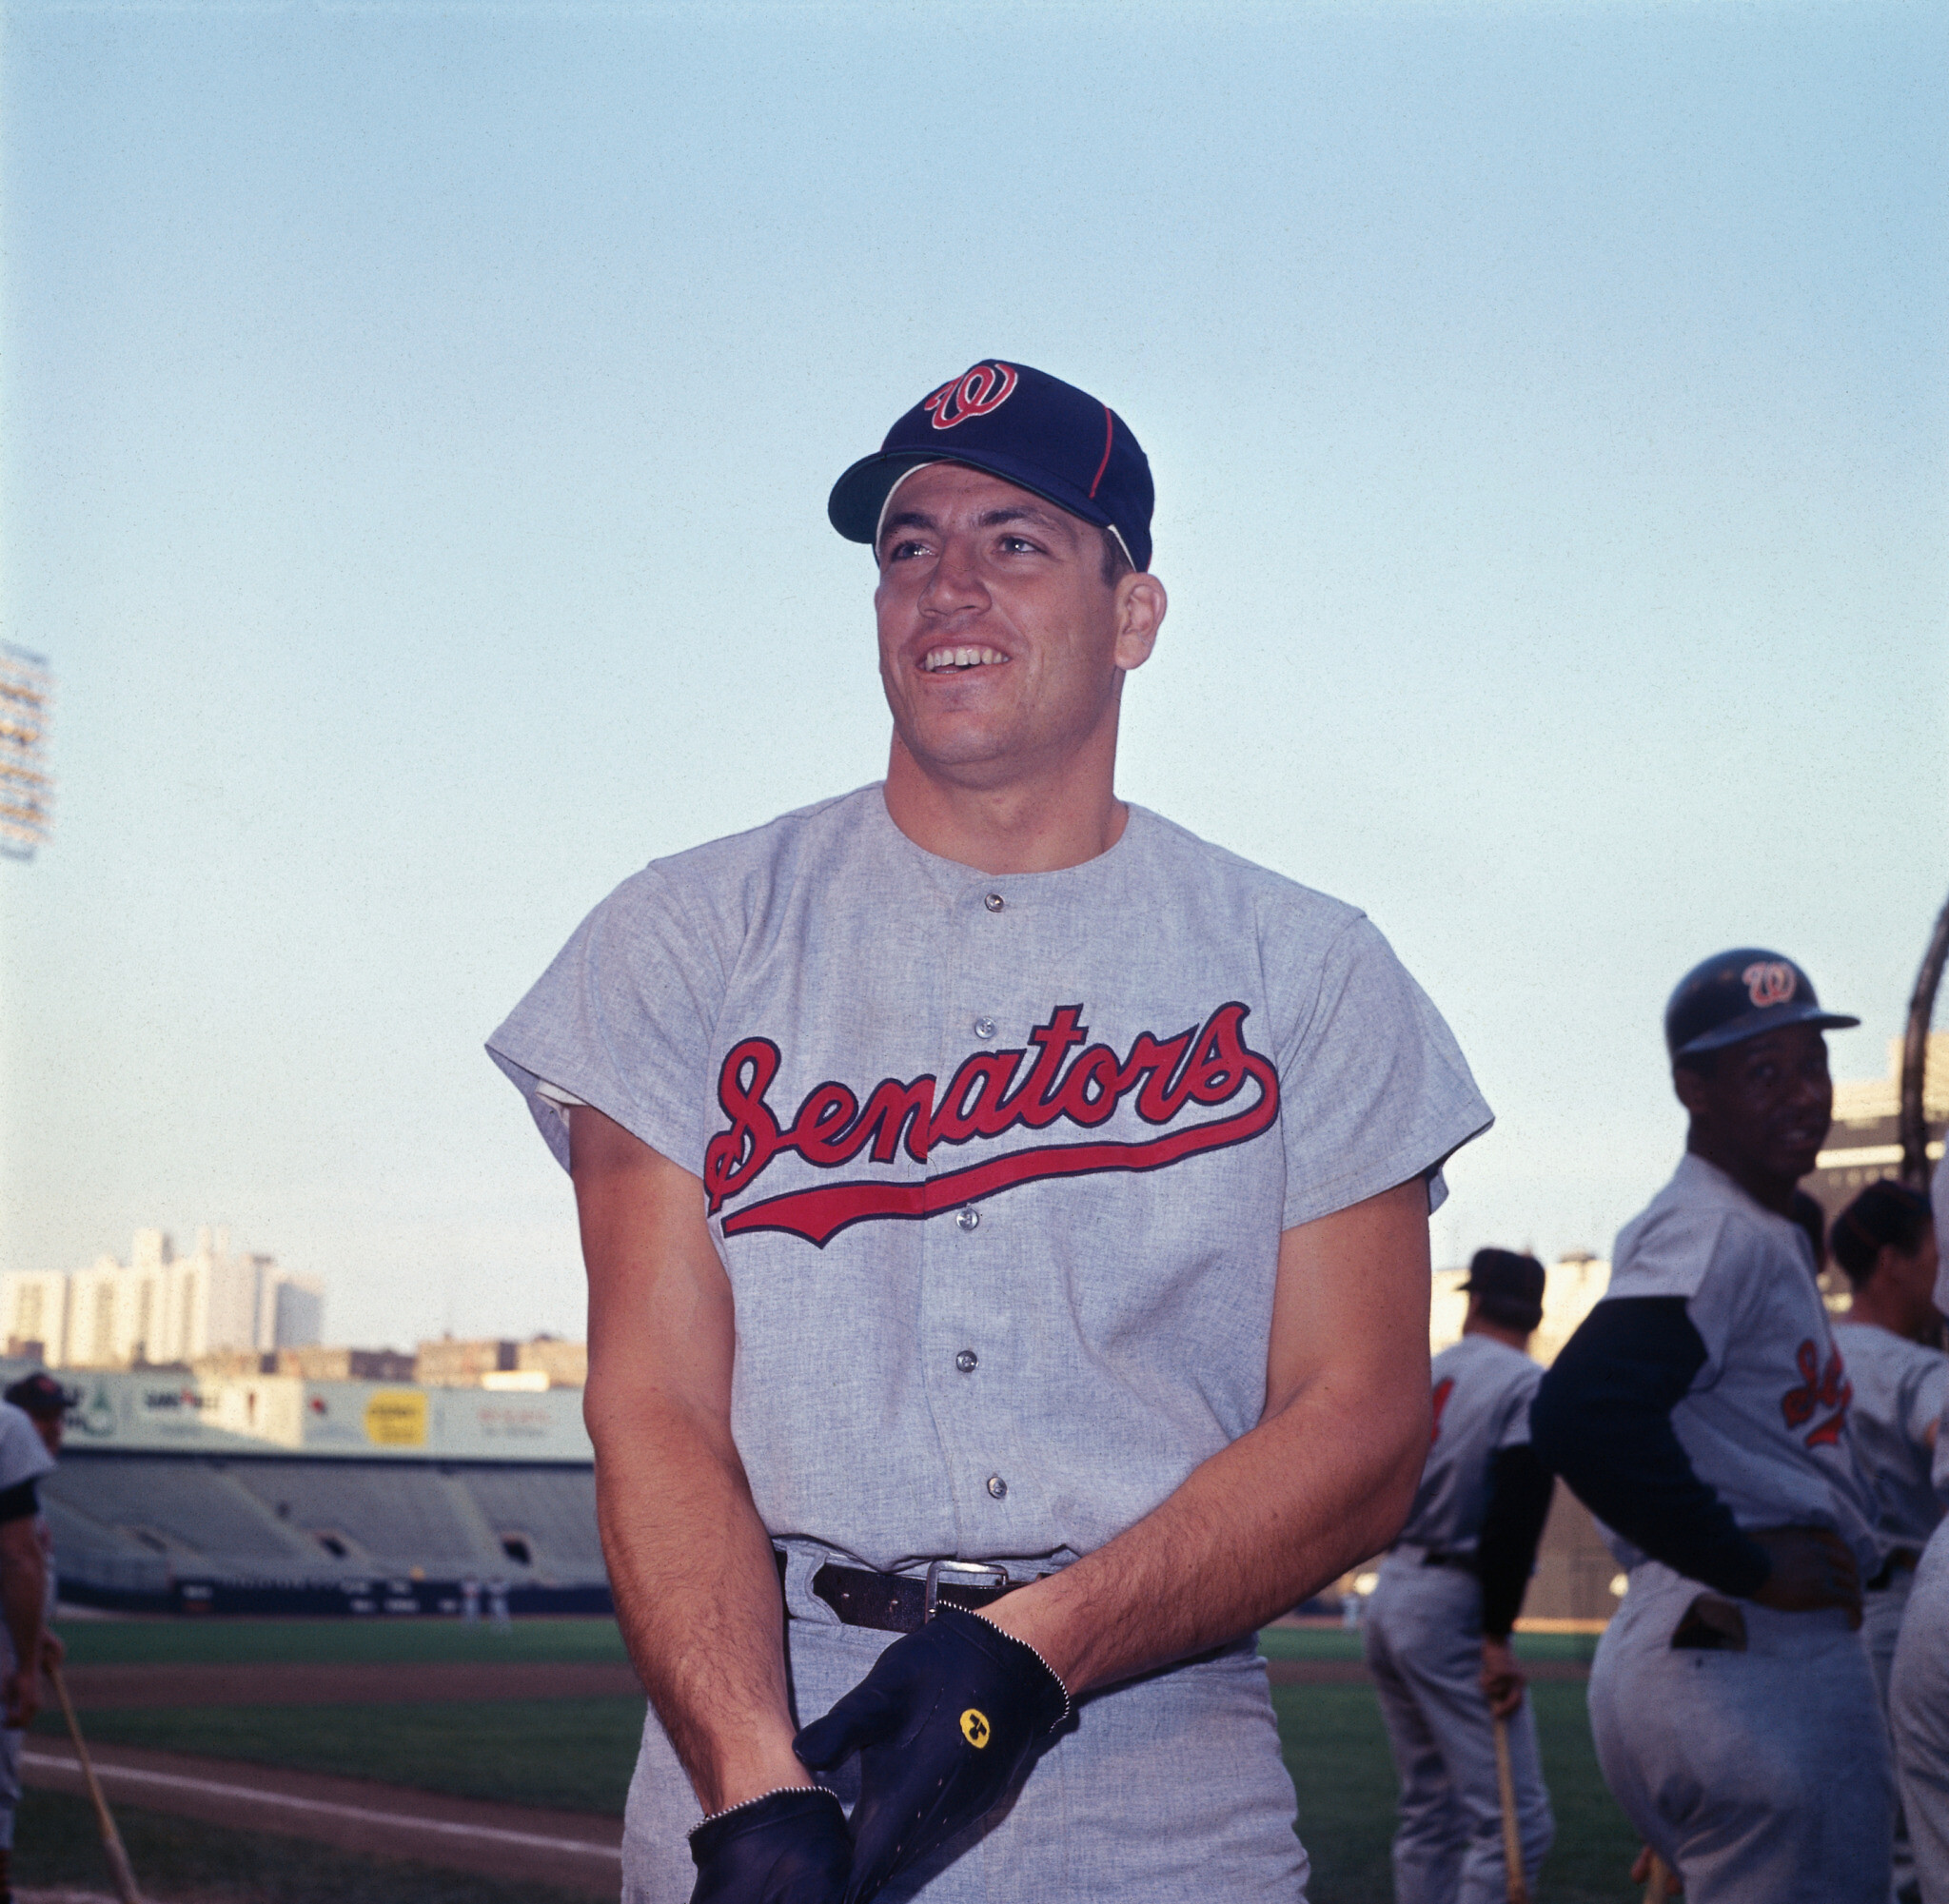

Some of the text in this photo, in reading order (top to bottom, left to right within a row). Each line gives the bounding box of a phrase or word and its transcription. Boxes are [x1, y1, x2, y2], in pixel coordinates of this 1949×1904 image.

[923, 363, 1018, 430] W
[1742, 961, 1797, 1008] W
[704, 1001, 1281, 1249] Senators
